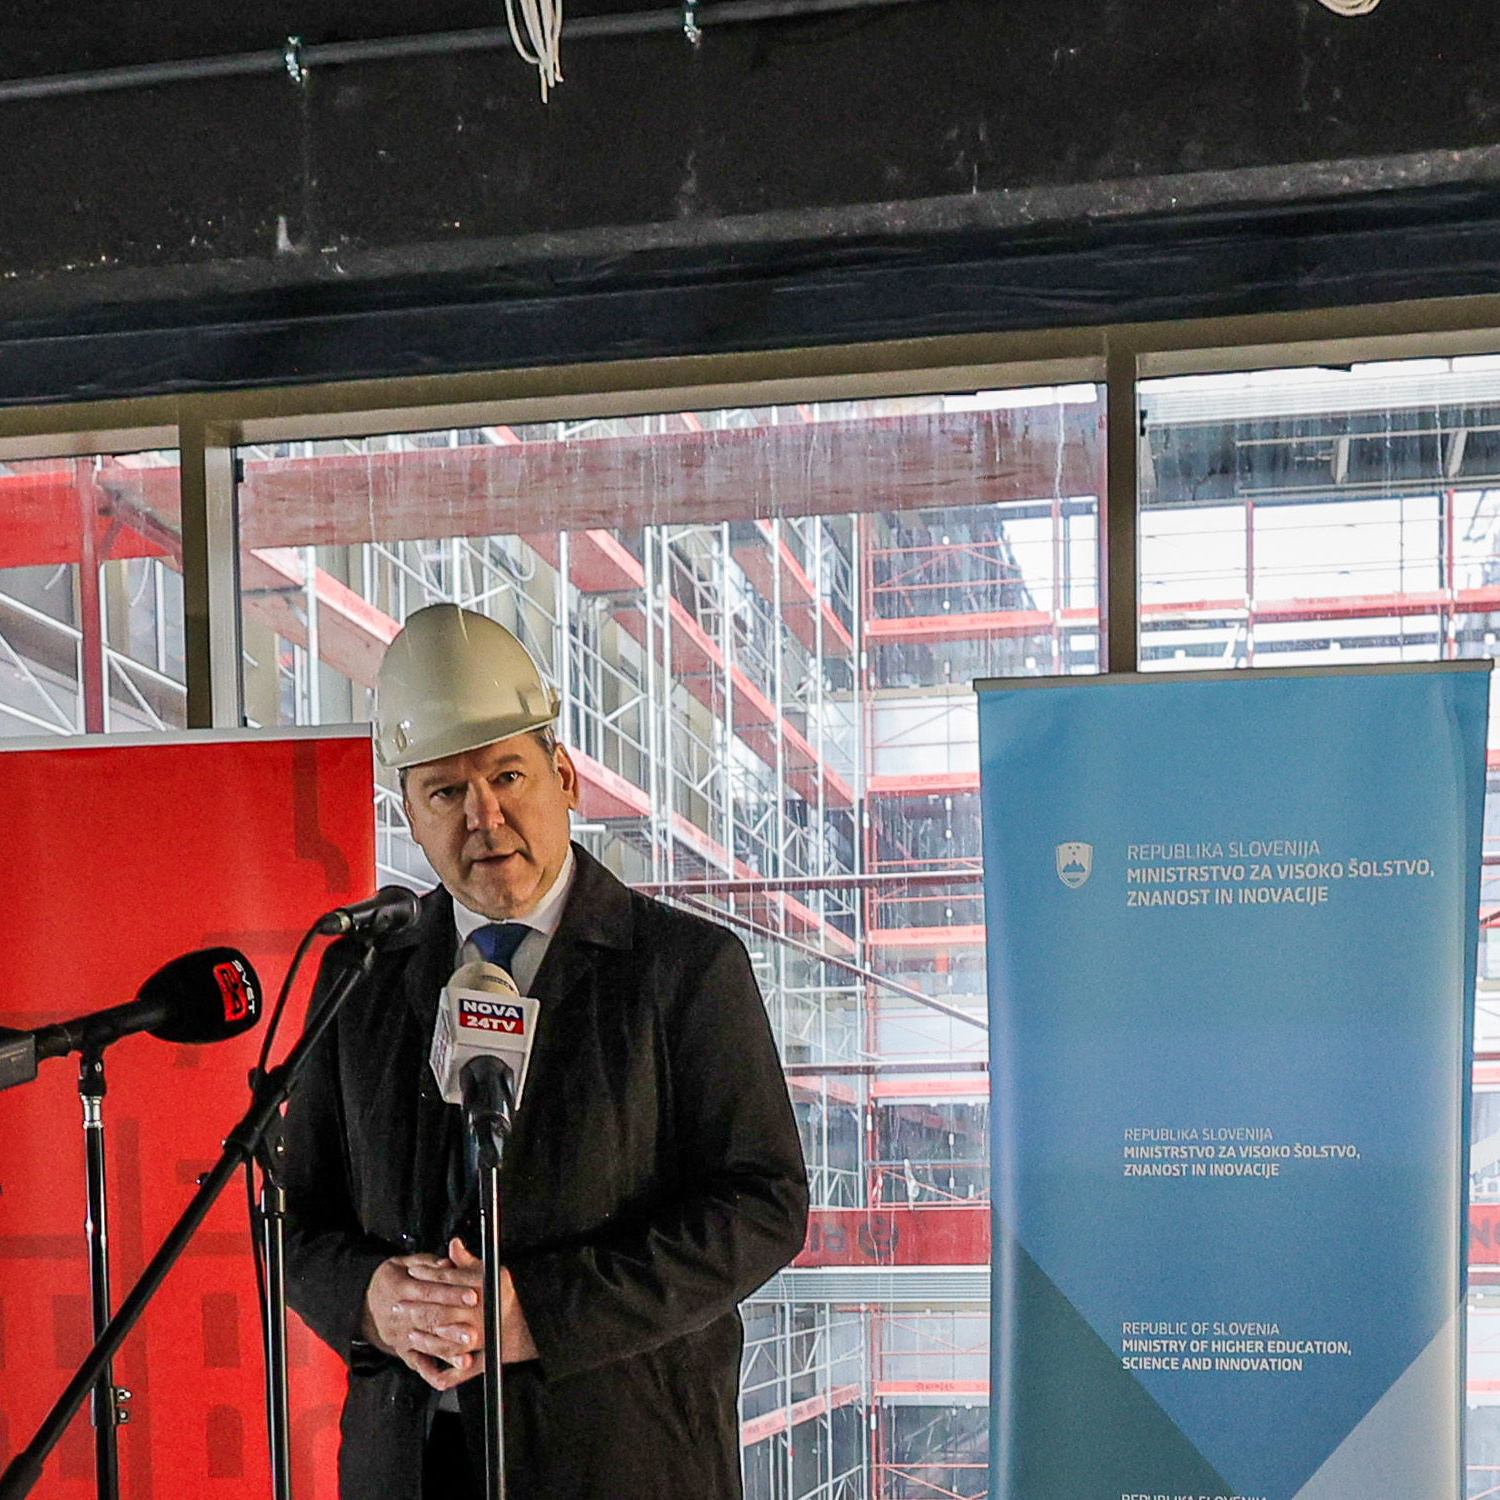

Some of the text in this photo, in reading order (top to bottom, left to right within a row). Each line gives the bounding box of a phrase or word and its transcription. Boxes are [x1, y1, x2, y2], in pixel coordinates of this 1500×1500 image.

[1127, 840, 1320, 860] REPUBLIKA SLOVENIJA
[1127, 857, 1436, 884] MINISTRSTVO ZA VISOKO ŠOLSTVO,
[1127, 886, 1329, 907] ZNANOST IN INOVACIJE
[463, 1000, 520, 1018] NOVA
[467, 1015, 517, 1032] 24TV
[1124, 1127, 1273, 1142] REPUBLIKA SLOVENIJA
[1123, 1140, 1361, 1160] MINISTRSTVO ZA VISOKO ŠOLSTVO,
[1123, 1162, 1279, 1179] ZNANOST IN INOVACIJE
[1122, 1321, 1280, 1336] REPUBLIC OF SLOVENIA
[1122, 1340, 1352, 1357] MINISTRY OF HIGHER EDUCATION,
[1122, 1357, 1303, 1372] SCIENCE AND INNOVATION
